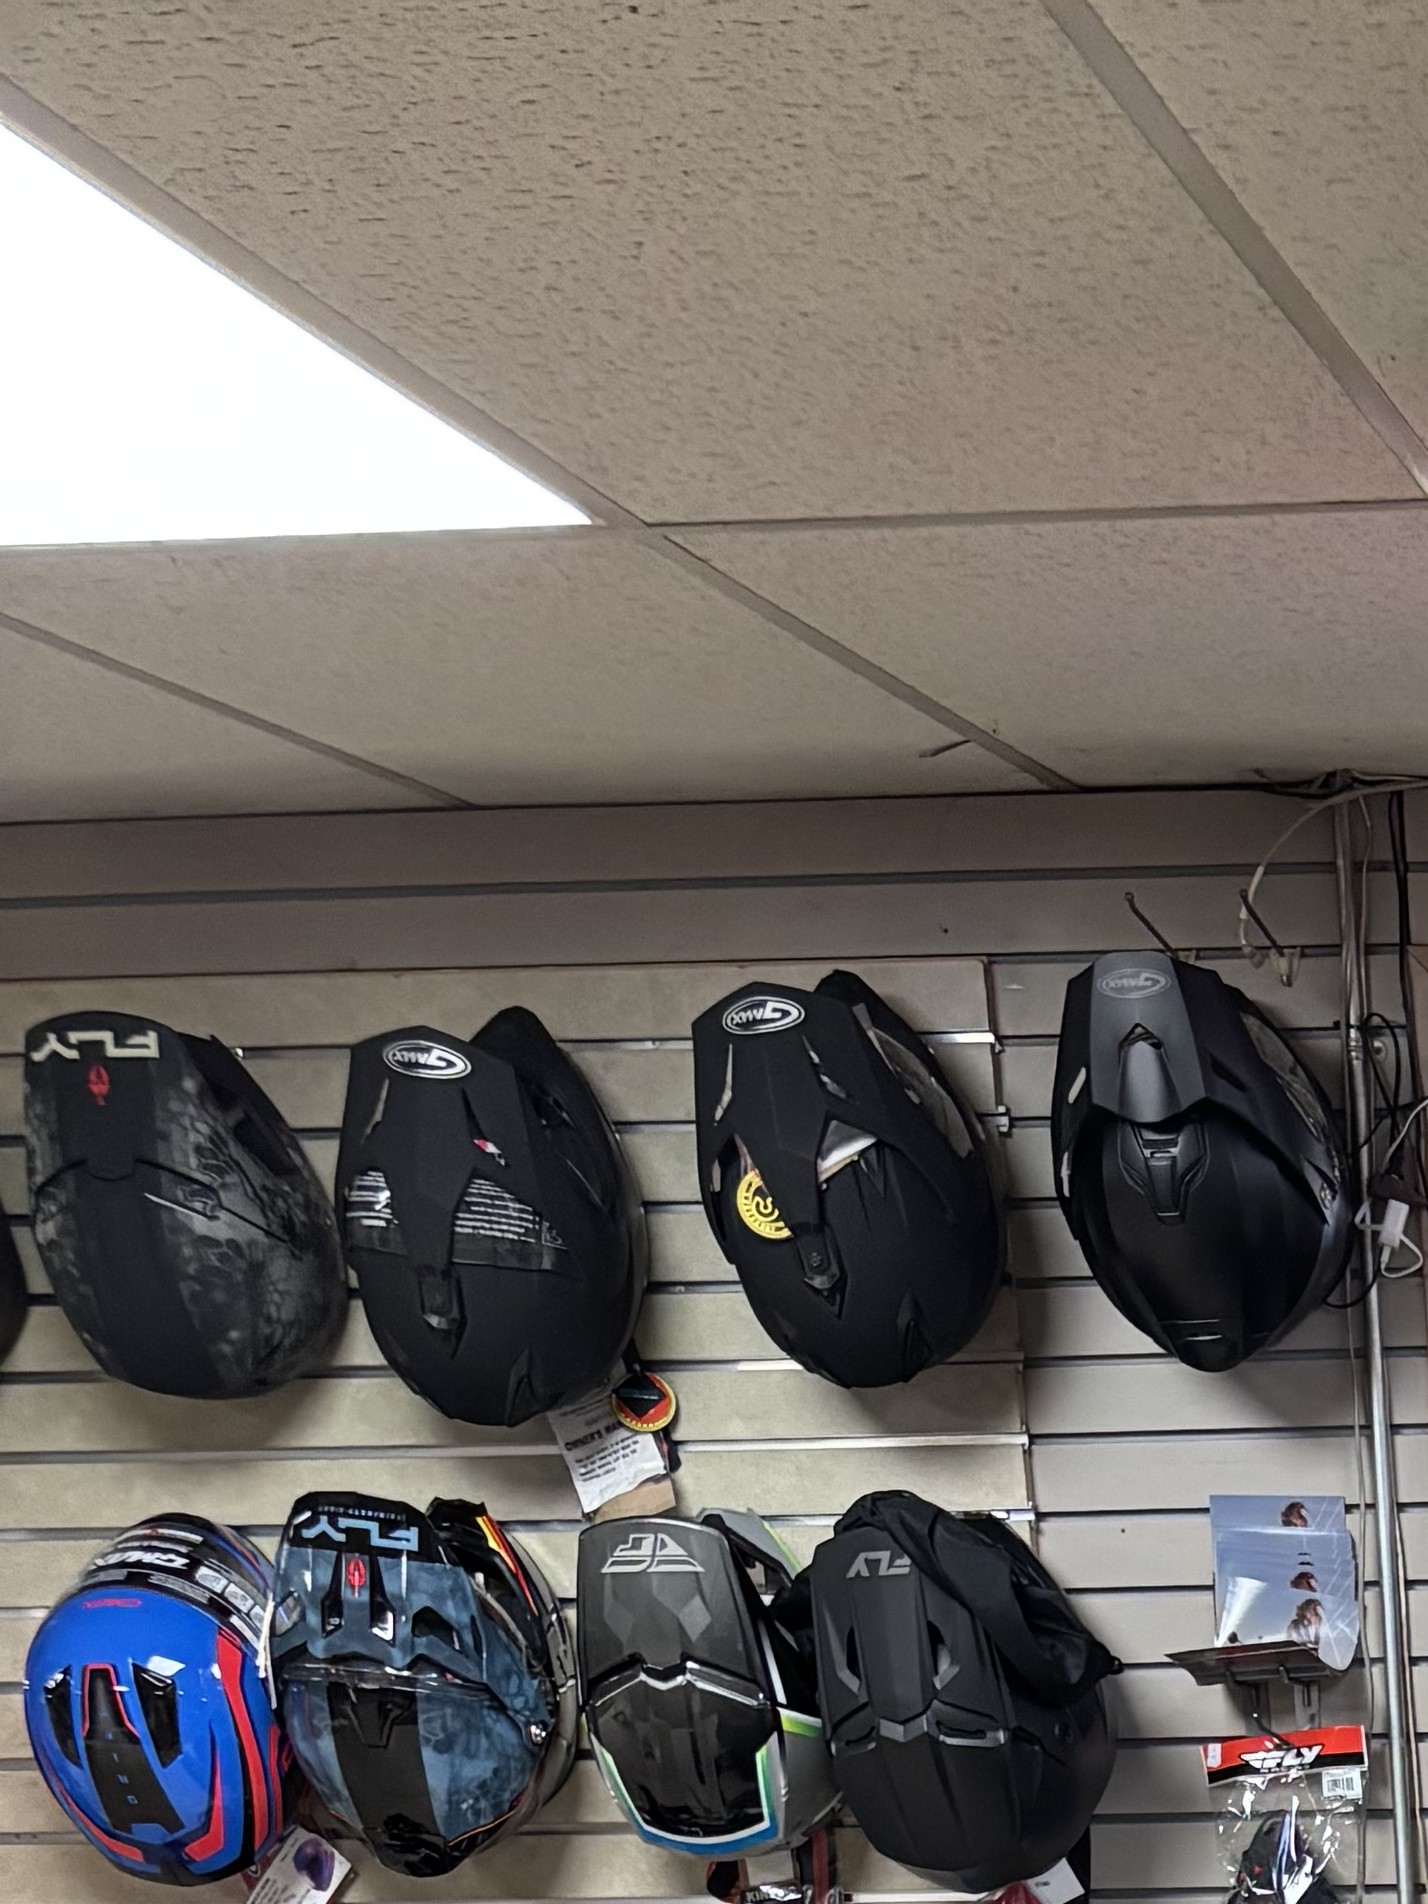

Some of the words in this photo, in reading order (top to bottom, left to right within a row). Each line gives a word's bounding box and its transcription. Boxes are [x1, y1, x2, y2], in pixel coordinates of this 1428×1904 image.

[731, 1000, 801, 1032] GMAX
[31, 1030, 160, 1063] FLY
[300, 1515, 419, 1552] FLY
[846, 1550, 912, 1578] FLY
